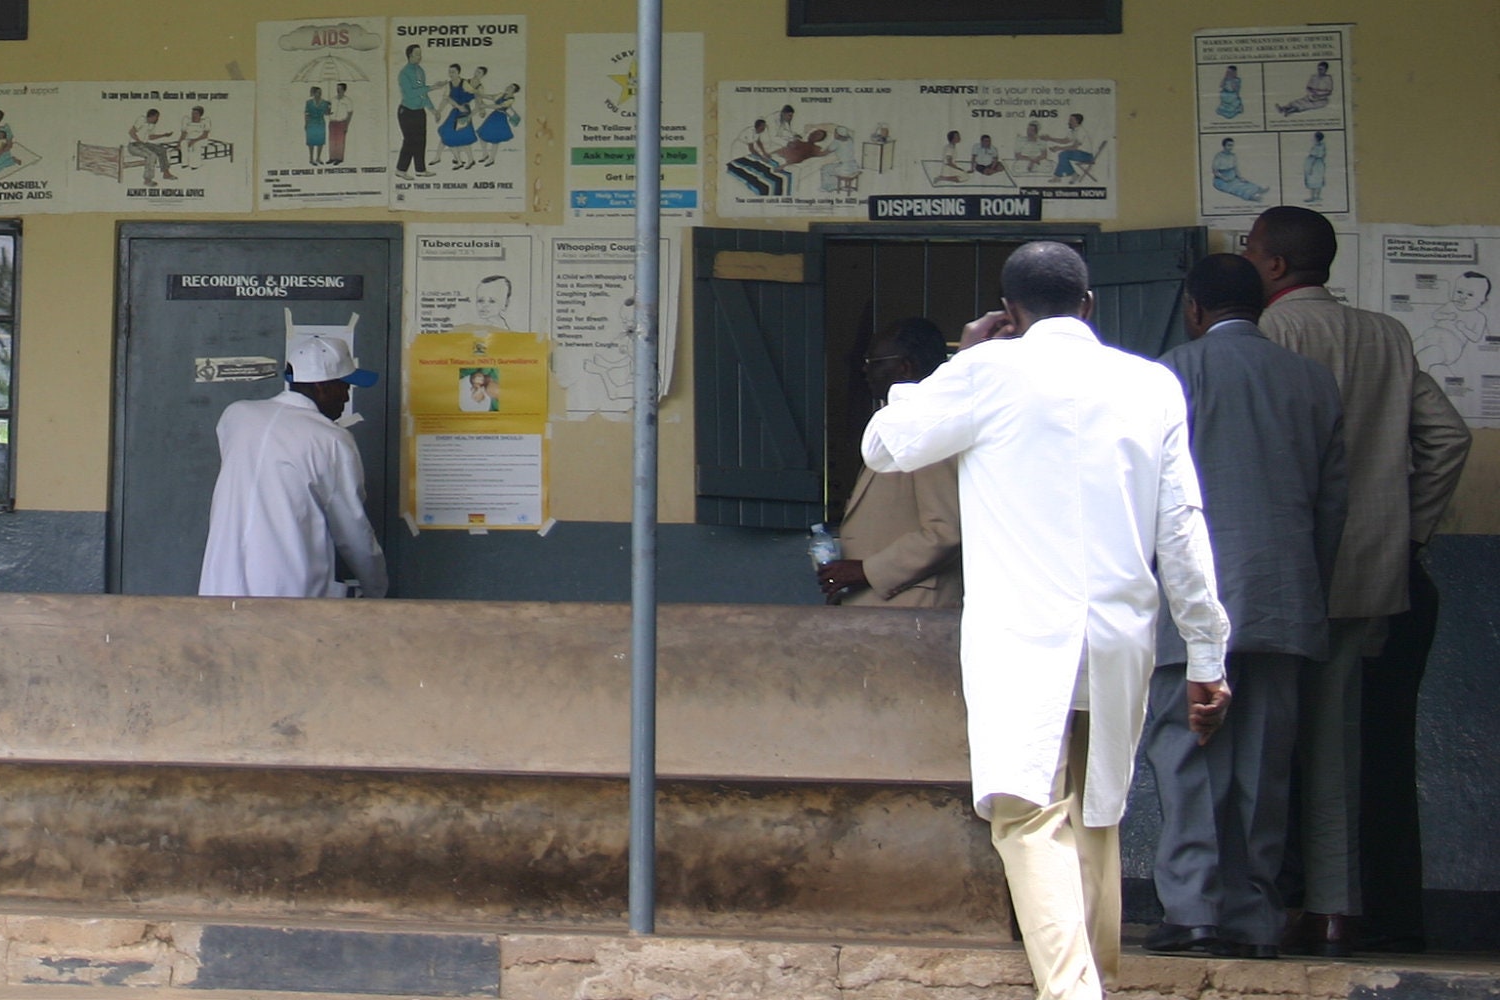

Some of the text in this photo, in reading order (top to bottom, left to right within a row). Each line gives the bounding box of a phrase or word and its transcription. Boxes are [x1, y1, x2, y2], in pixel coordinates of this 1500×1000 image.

[397, 25, 518, 36] SUPPORT YOUR
[311, 30, 349, 46] AIDS
[428, 37, 492, 47] FRIENDS
[31, 87, 59, 95] support
[920, 86, 978, 94] PARENTS!
[1005, 87, 1027, 97] your
[1068, 87, 1111, 95] educate
[604, 98, 619, 113] YOU
[966, 99, 989, 107] your
[972, 110, 1058, 118] STDs and AIDS
[667, 152, 688, 160] help
[27, 191, 52, 200] AIDS
[127, 189, 204, 197] ALWAYS SEEK MEDICAL ADVICE
[877, 199, 966, 217] DISPENSING
[980, 198, 1031, 216] ROOM
[421, 240, 500, 248] Tuberculosis
[557, 243, 636, 252] Whooping Coug
[1418, 239, 1459, 247] Dosages
[182, 276, 258, 287] RECORDING
[266, 276, 277, 286] &
[236, 287, 287, 296] ROOMS
